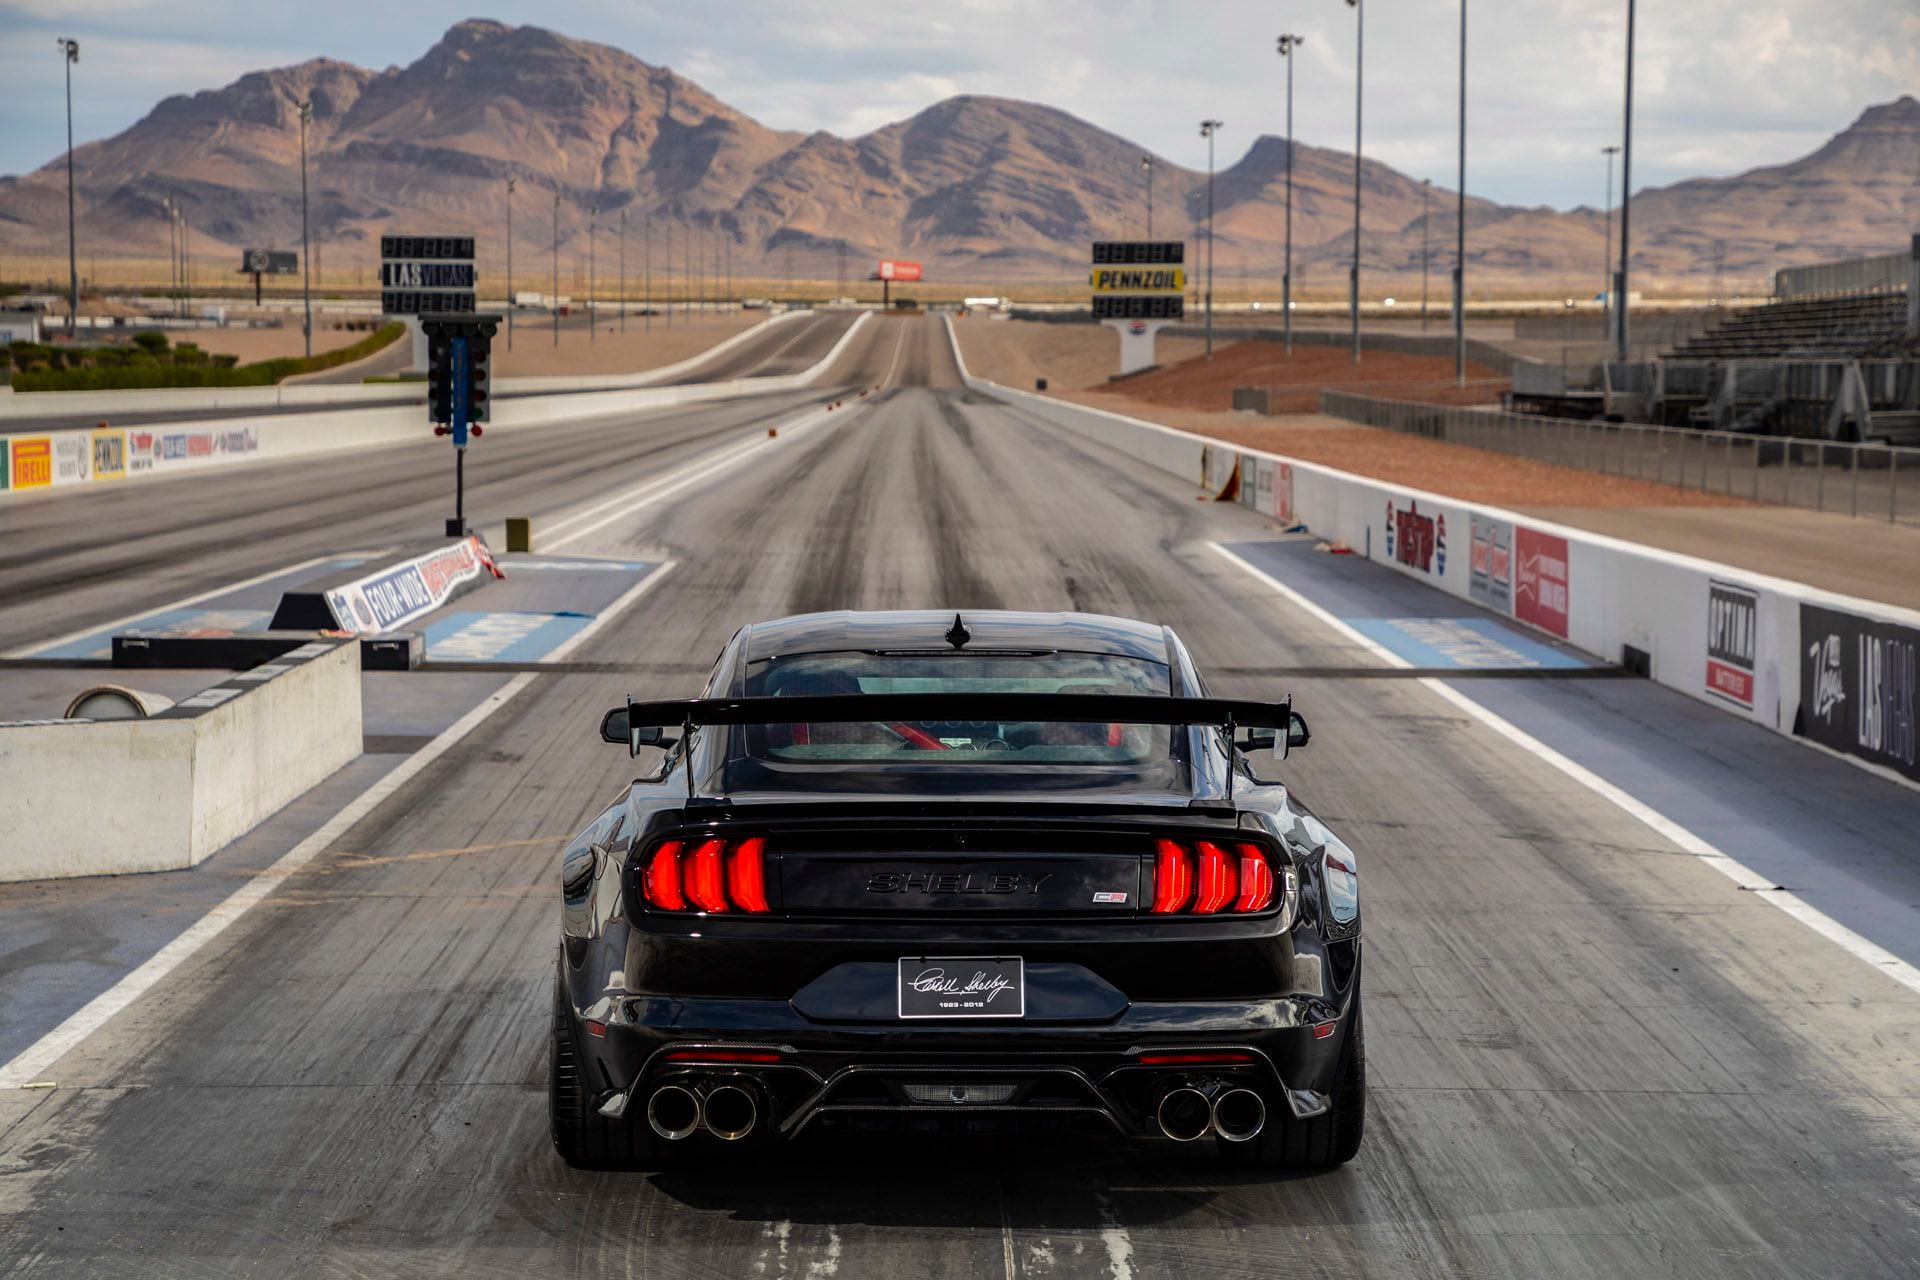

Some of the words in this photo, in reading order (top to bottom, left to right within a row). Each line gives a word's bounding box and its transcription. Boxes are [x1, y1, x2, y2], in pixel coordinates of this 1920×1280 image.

[1098, 270, 1177, 289] PENNZOIL
[12, 442, 51, 487] PIRELLI
[94, 436, 123, 473] PENNZOIL
[1710, 597, 1754, 660] OPTIMA
[865, 872, 1053, 894] SHELBY
[964, 971, 1015, 1003] Shelby
